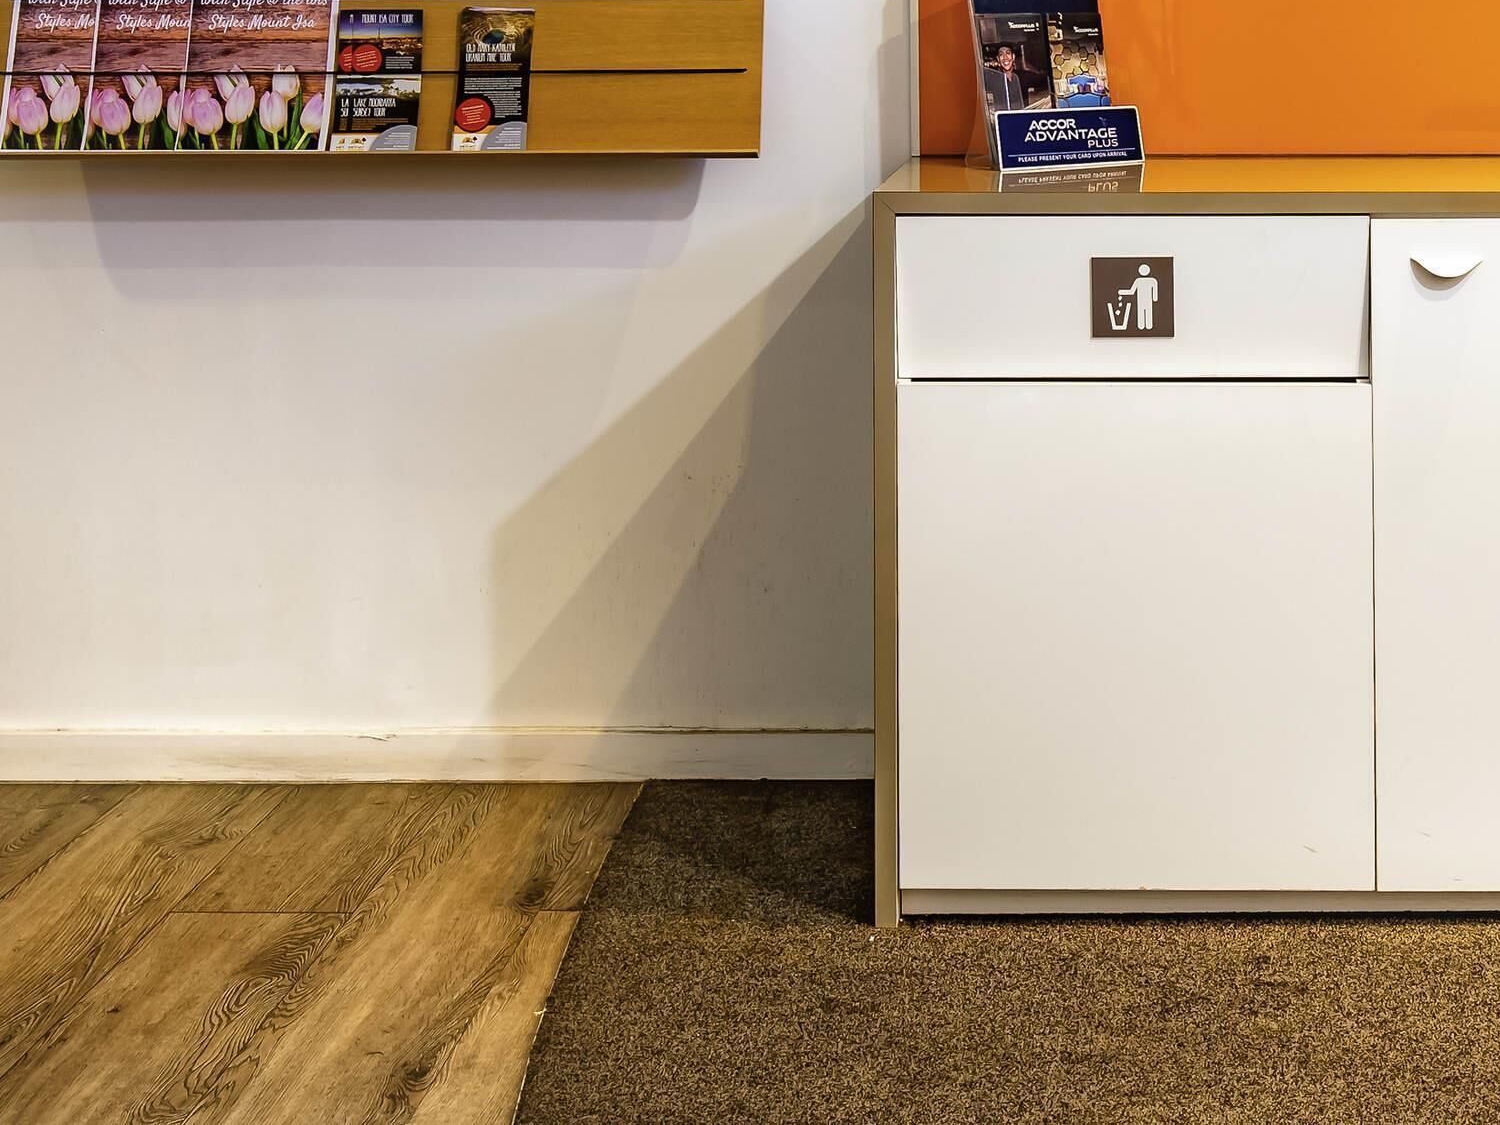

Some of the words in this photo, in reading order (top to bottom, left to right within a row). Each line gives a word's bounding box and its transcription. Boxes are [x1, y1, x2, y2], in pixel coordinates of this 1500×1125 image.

[36, 13, 71, 33] Styles
[116, 13, 152, 33] Styles
[208, 14, 245, 33] Styles
[247, 14, 291, 30] Mount
[292, 14, 316, 30] Isa
[388, 14, 400, 24] CITY
[1028, 118, 1077, 131] ACCOR
[1024, 127, 1118, 143] ADVANTAGE
[1087, 138, 1119, 149] PLUS
[1018, 155, 1038, 163] PLEASE
[1039, 154, 1062, 162] PRESENT
[1092, 151, 1106, 159] UPON
